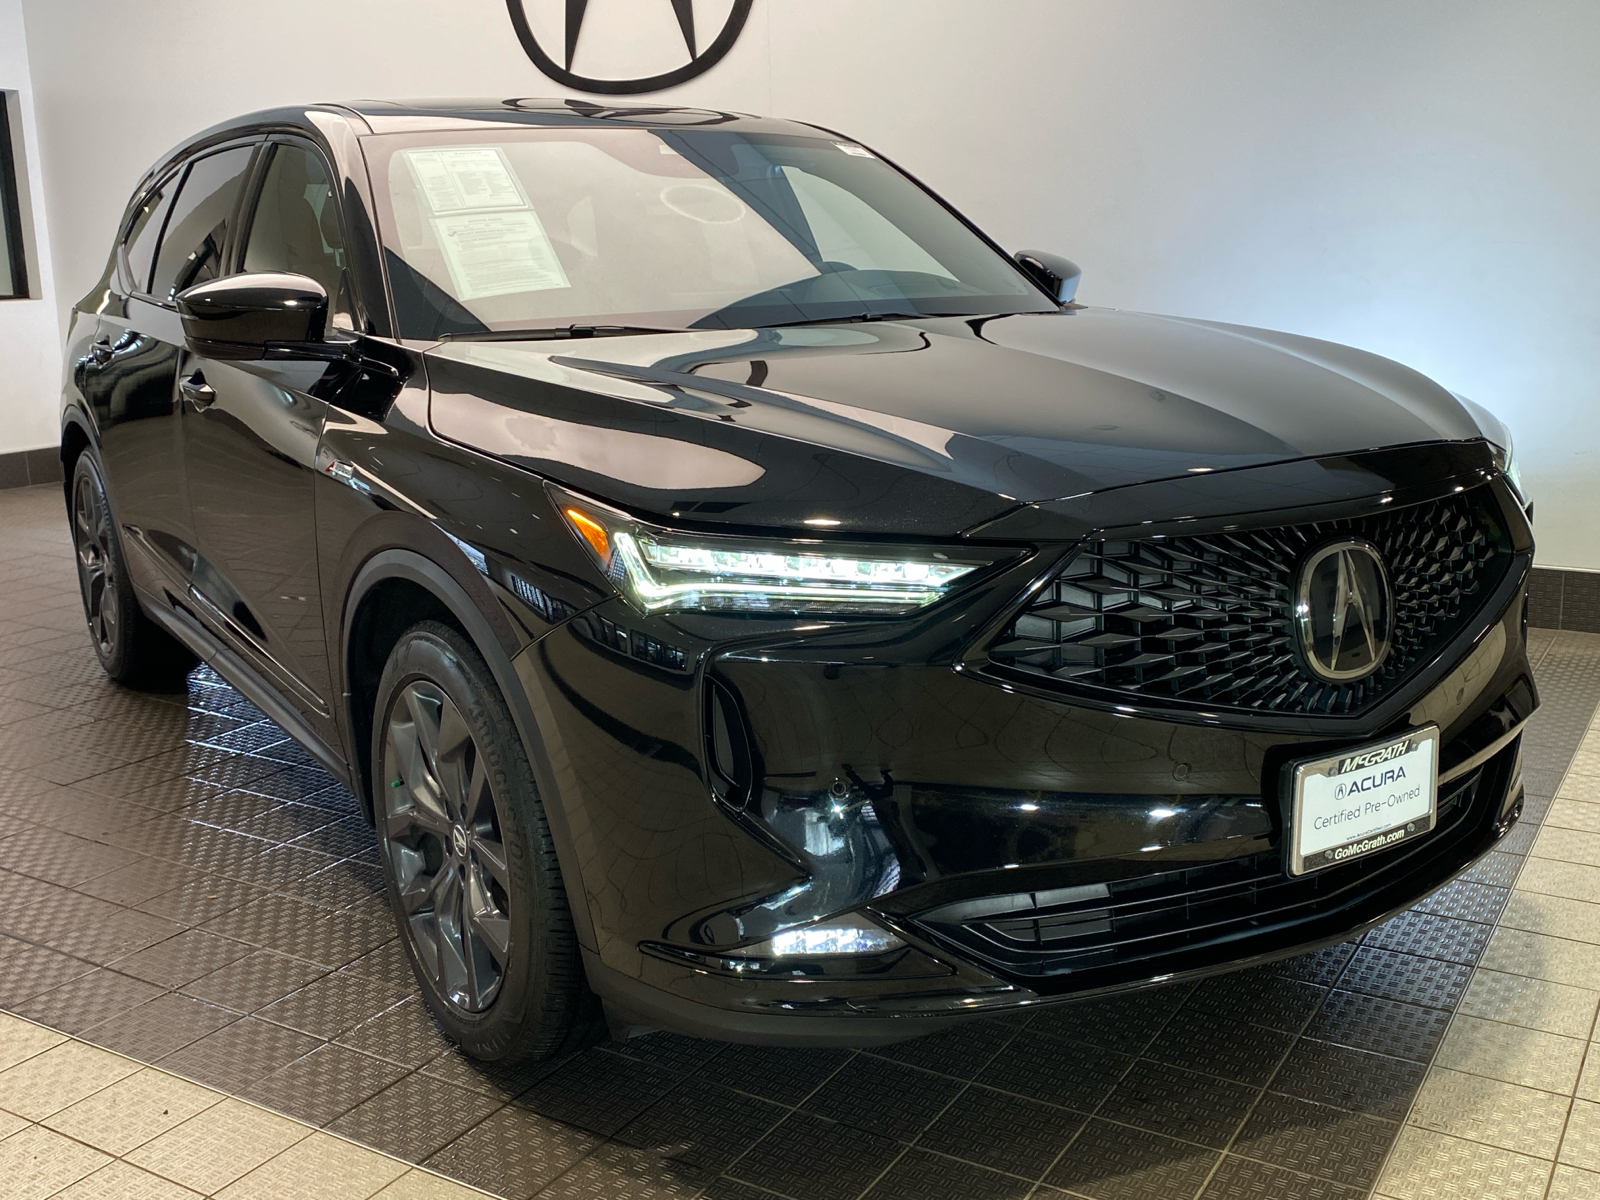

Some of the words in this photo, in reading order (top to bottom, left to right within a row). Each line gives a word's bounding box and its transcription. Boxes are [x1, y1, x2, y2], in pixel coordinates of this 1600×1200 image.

[1347, 766, 1406, 796] ACURA
[1314, 805, 1361, 830] Certified
[1364, 784, 1420, 815] Pre-Owned
[1335, 829, 1405, 860] GoMcGrath.com
